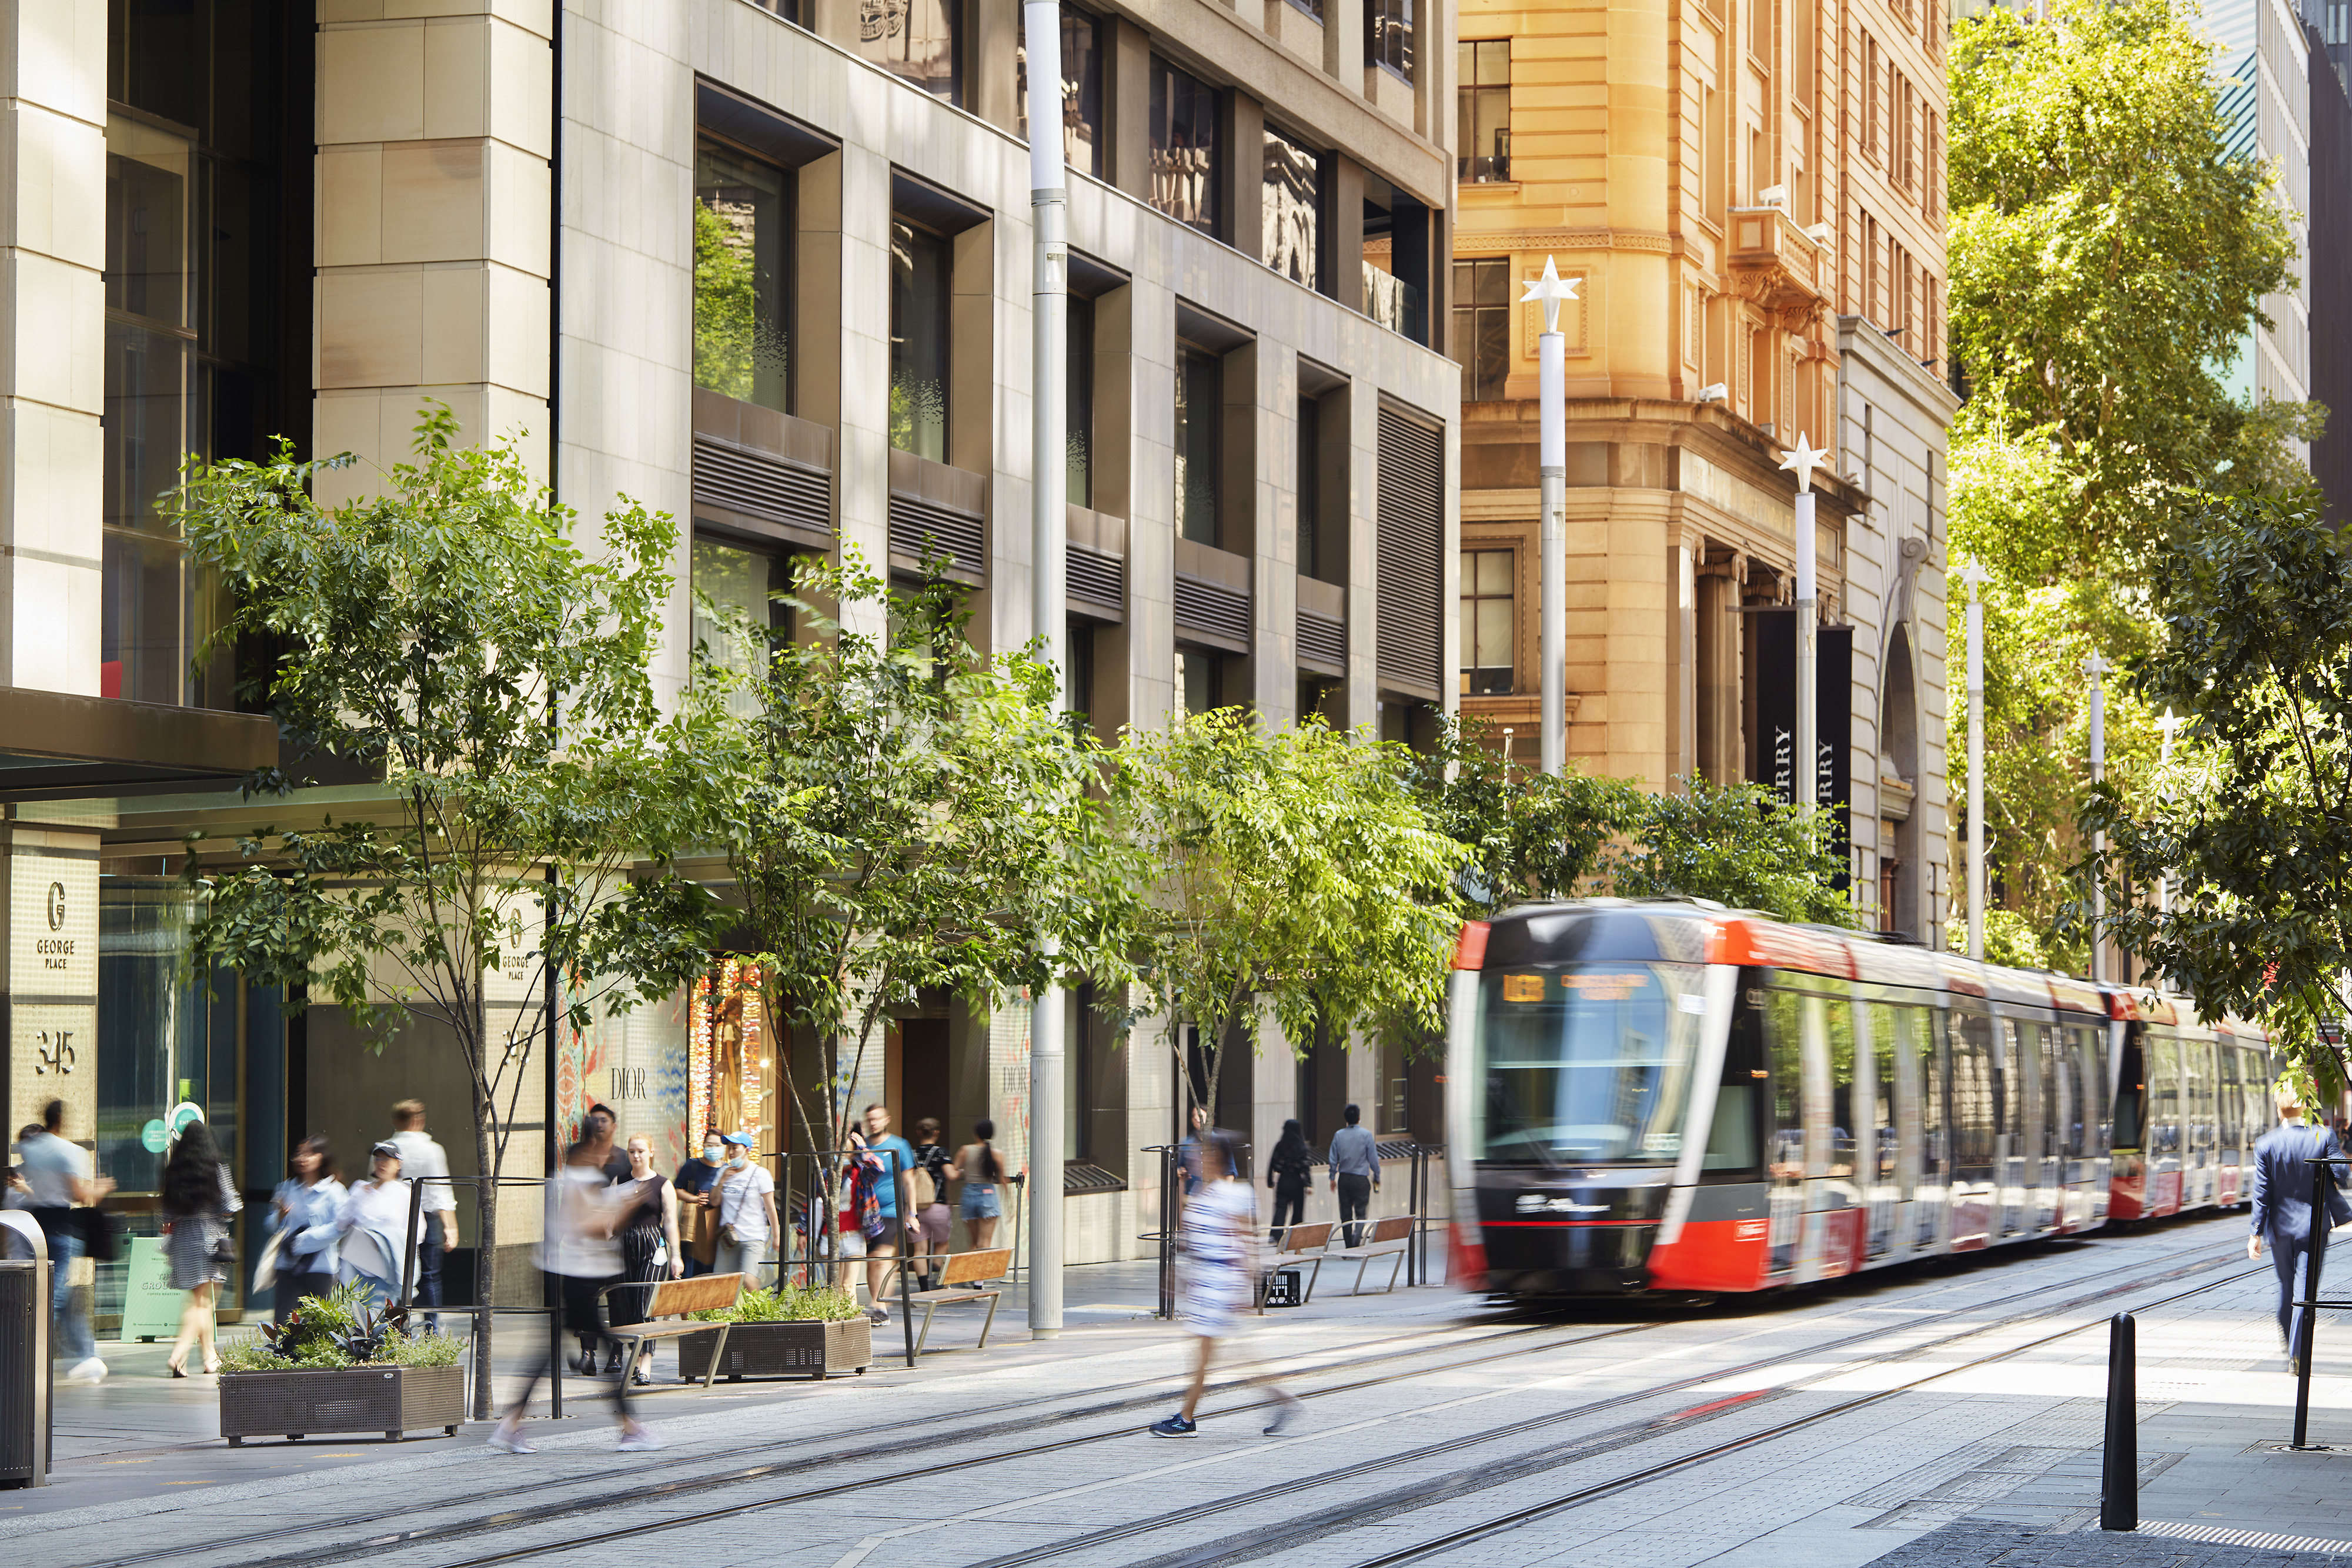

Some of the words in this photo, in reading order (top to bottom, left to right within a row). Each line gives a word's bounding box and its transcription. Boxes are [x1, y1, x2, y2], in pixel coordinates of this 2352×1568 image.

[36, 940, 75, 955] GEORGE
[45, 958, 67, 969] PLACE
[502, 955, 529, 969] GEORGE
[508, 971, 524, 981] PLACE
[35, 1030, 75, 1075] 345
[611, 1066, 647, 1100] DIOR
[1003, 1066, 1027, 1093] DIOR
